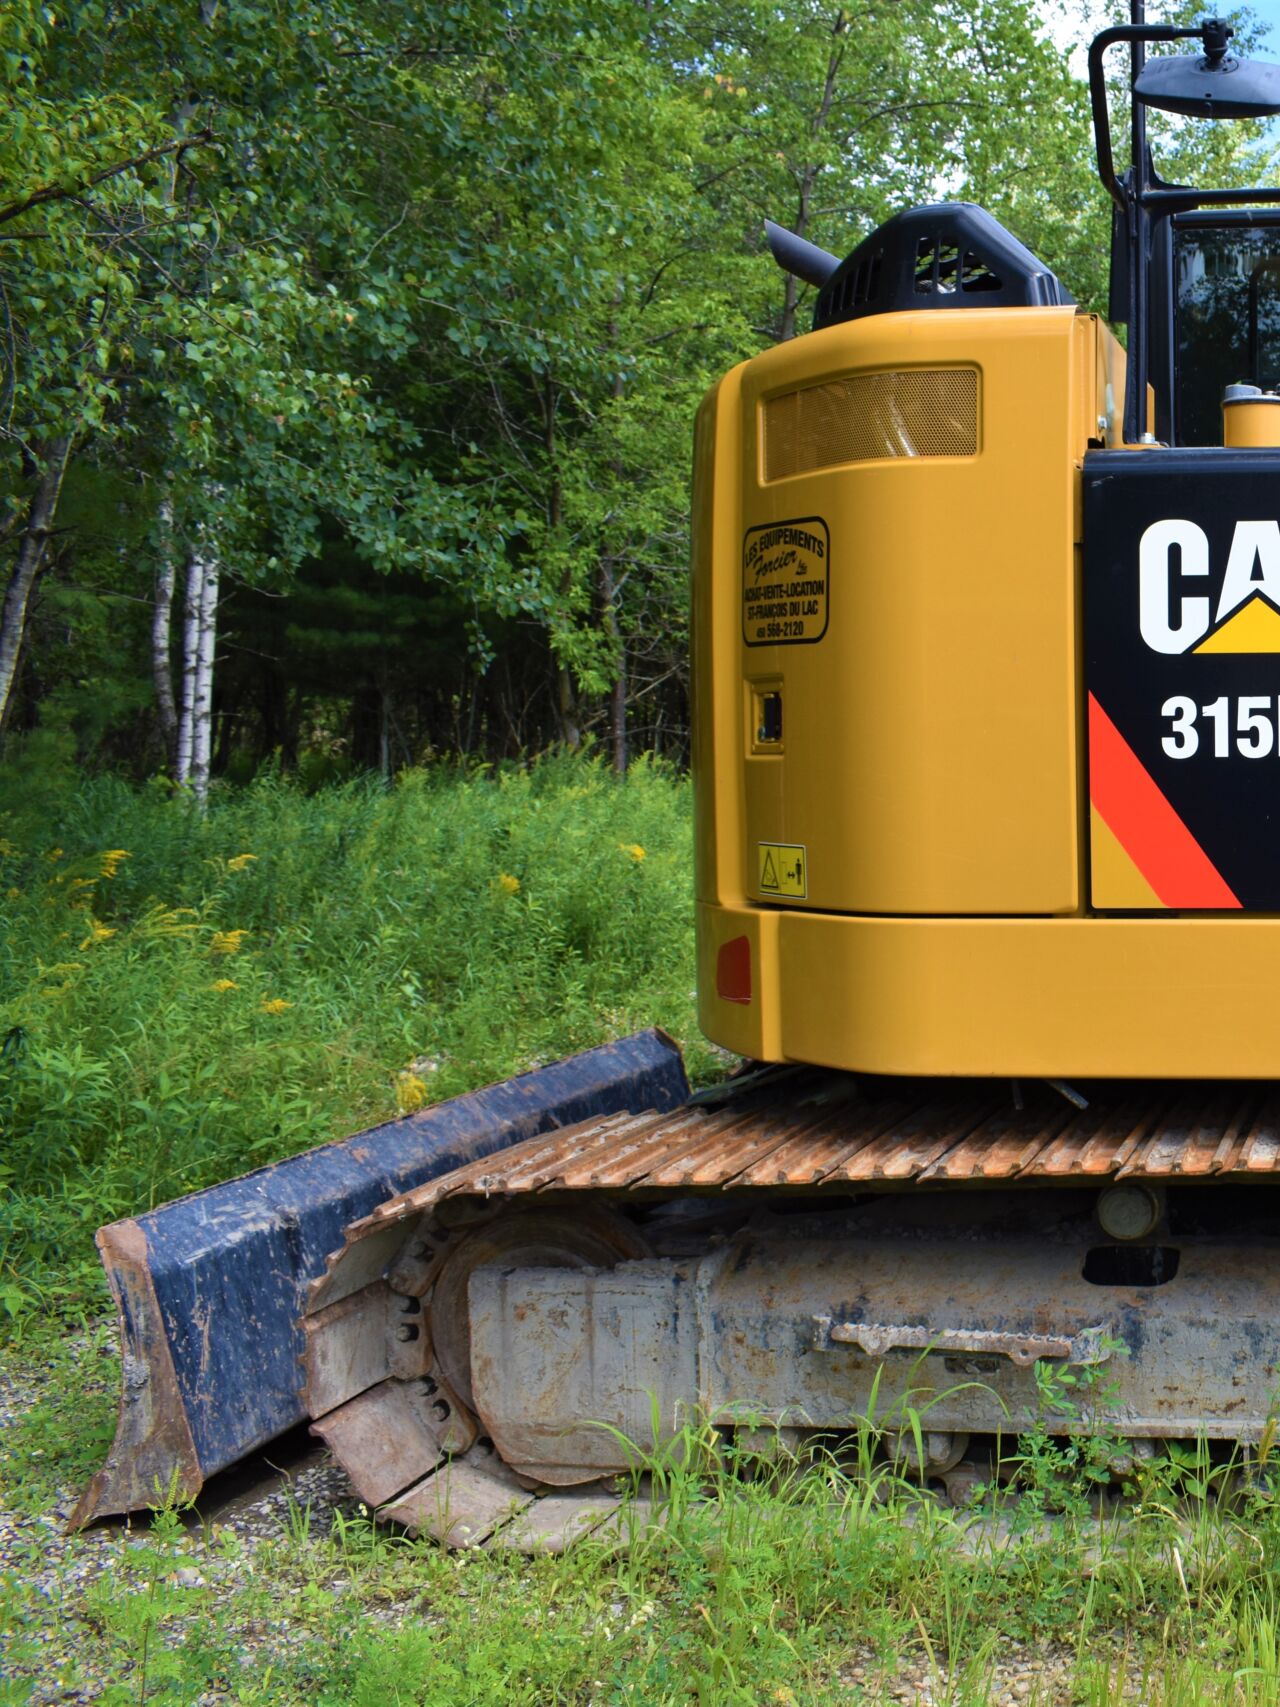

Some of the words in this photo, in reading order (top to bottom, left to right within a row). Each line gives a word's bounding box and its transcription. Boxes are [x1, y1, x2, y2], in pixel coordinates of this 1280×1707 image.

[745, 541, 758, 568] LES
[759, 528, 824, 558] EQUIPEMENTS
[753, 550, 798, 585] Forcier
[744, 580, 825, 602] ACHAT-VENTE-LOCATION
[789, 602, 800, 617] DU
[802, 600, 818, 616] LAC
[767, 620, 804, 637] 568-2120
